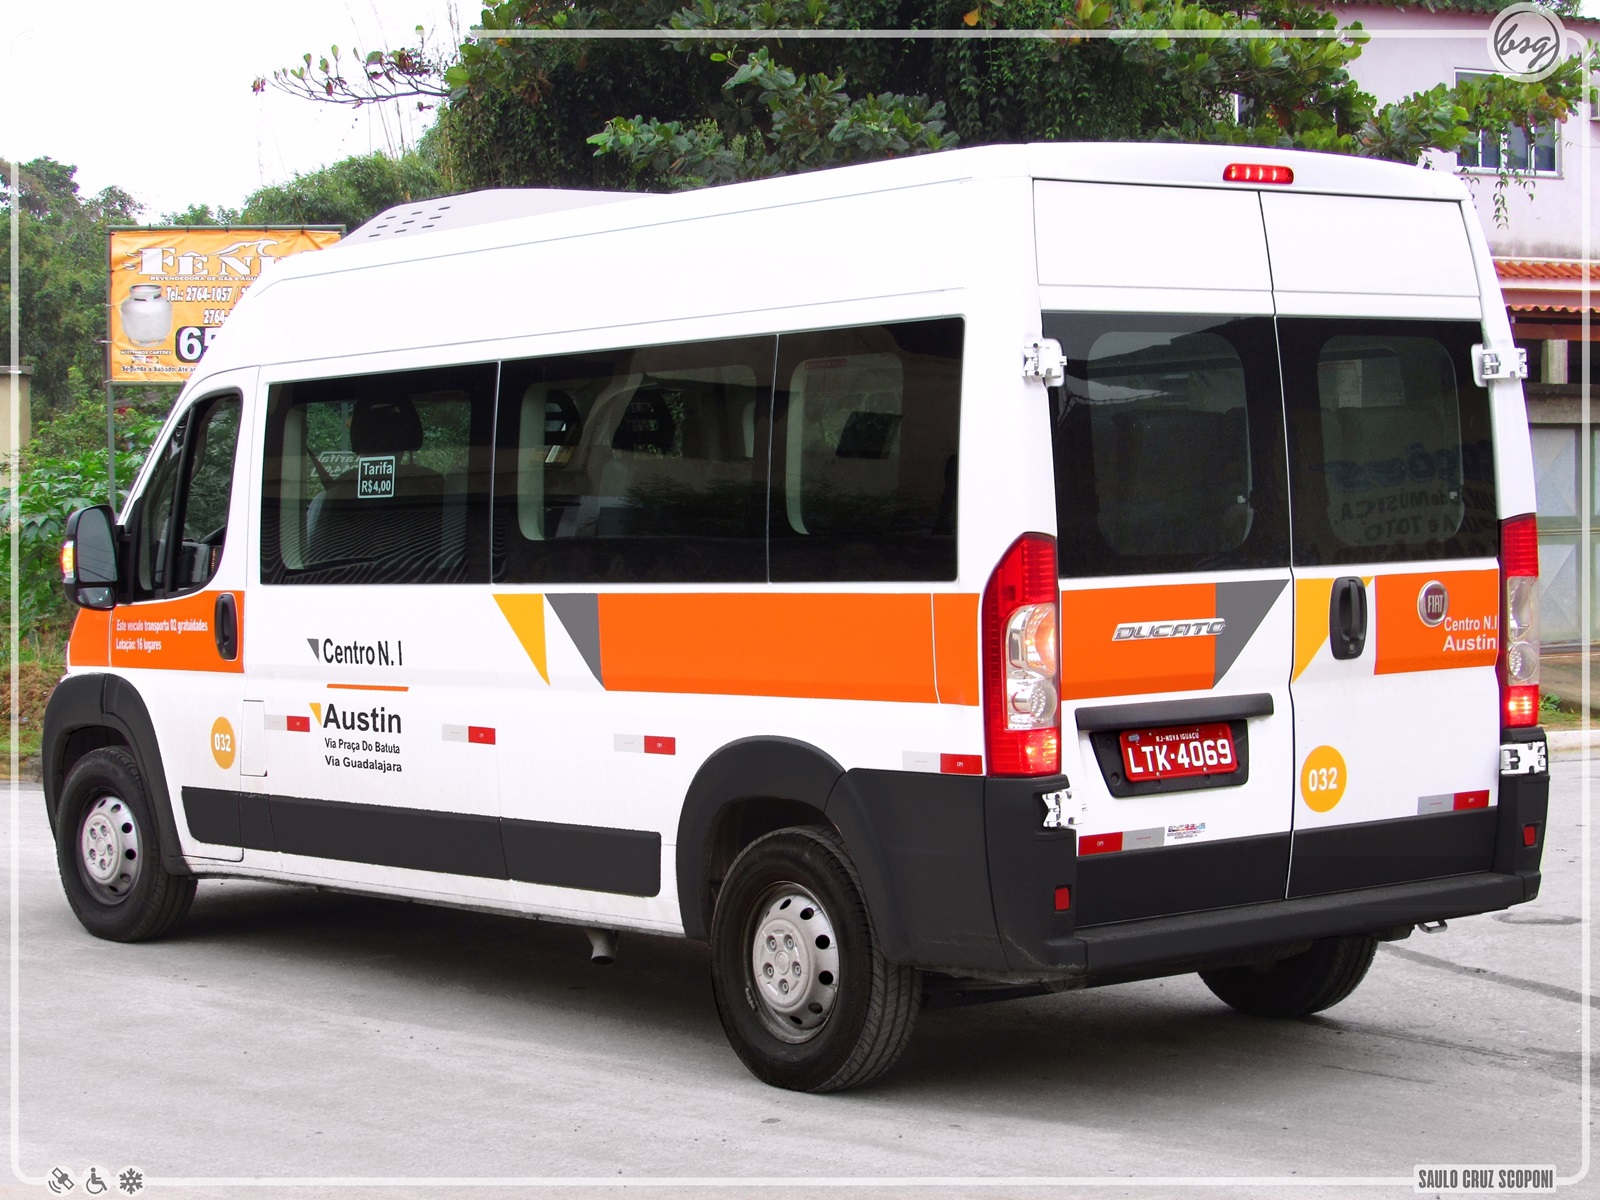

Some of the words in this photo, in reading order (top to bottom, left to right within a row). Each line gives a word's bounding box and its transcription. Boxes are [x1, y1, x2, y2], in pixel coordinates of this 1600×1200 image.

[185, 285, 233, 302] 2764-1057
[363, 462, 393, 475] Tarifa
[361, 479, 391, 494] R$4,00
[1427, 594, 1443, 614] FIAT
[116, 619, 127, 631] Este
[144, 619, 170, 634] transporta
[170, 618, 177, 631] 02
[177, 618, 208, 634] gratuidades
[1112, 618, 1226, 641] DUCATO
[1443, 616, 1480, 631] Centro
[143, 637, 162, 653] lugares
[323, 638, 375, 665] Centro
[1443, 634, 1497, 652] Austin
[323, 703, 402, 734] Austin
[214, 733, 231, 752] 032
[324, 737, 337, 749] Via
[338, 739, 360, 752] Praça
[362, 740, 374, 752] Do
[375, 741, 400, 754] Batuta
[325, 755, 340, 767] Via
[342, 756, 402, 773] Guadalajara
[1308, 766, 1338, 792] 032
